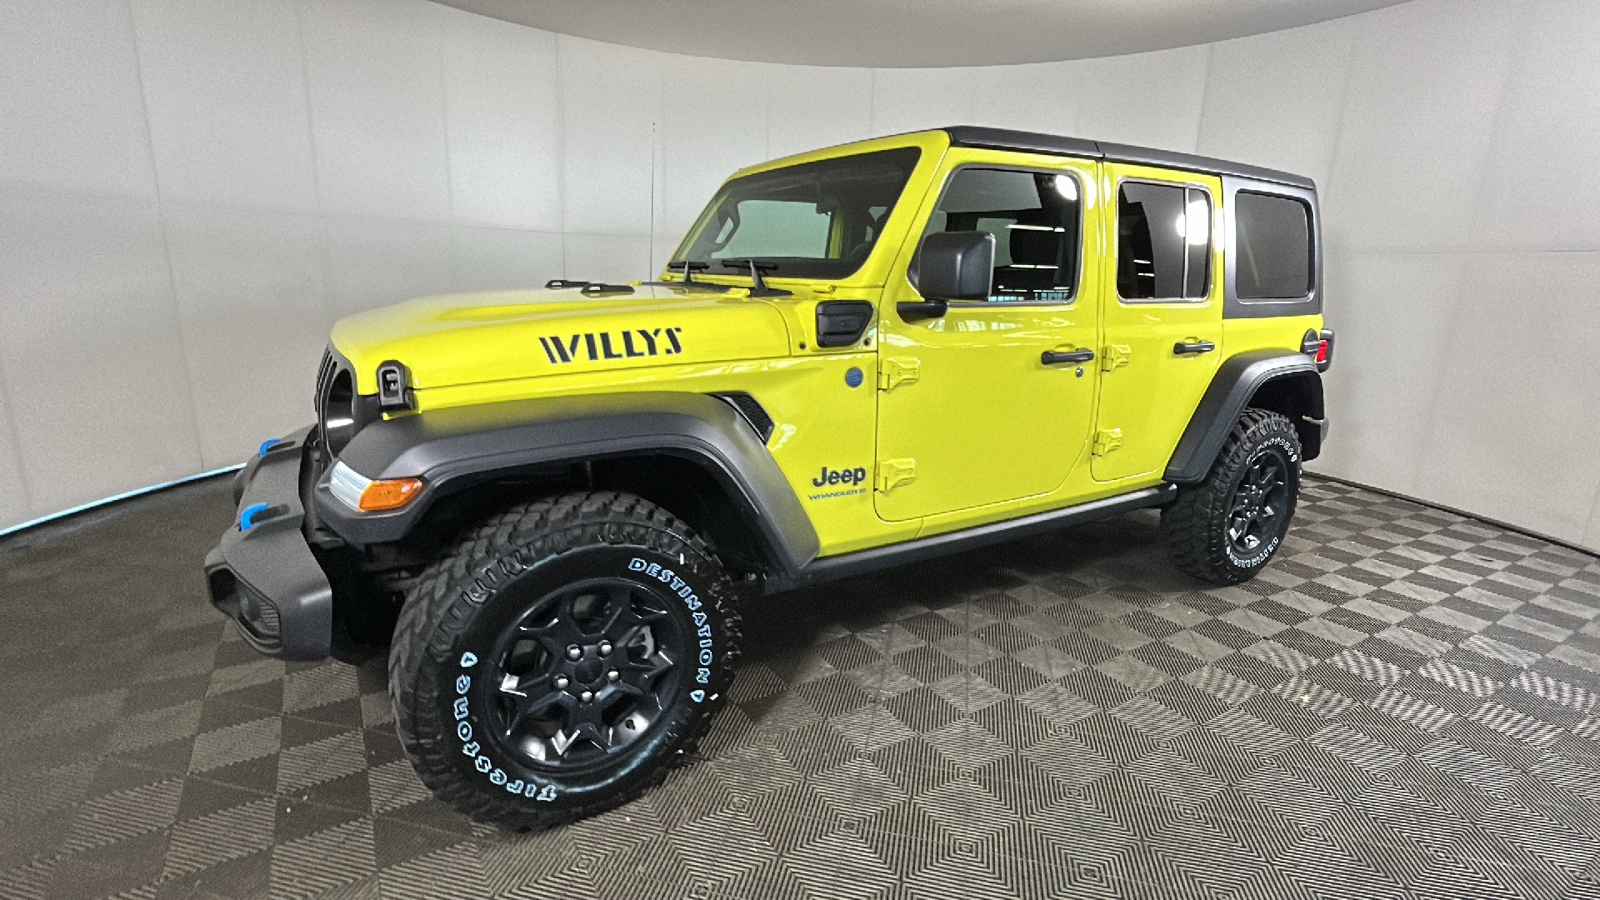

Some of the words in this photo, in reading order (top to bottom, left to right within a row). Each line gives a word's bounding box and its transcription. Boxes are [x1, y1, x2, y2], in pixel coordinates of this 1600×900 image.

[538, 327, 682, 364] WILLYS
[812, 466, 867, 487] Jeep
[628, 557, 713, 684] DESTINATION
